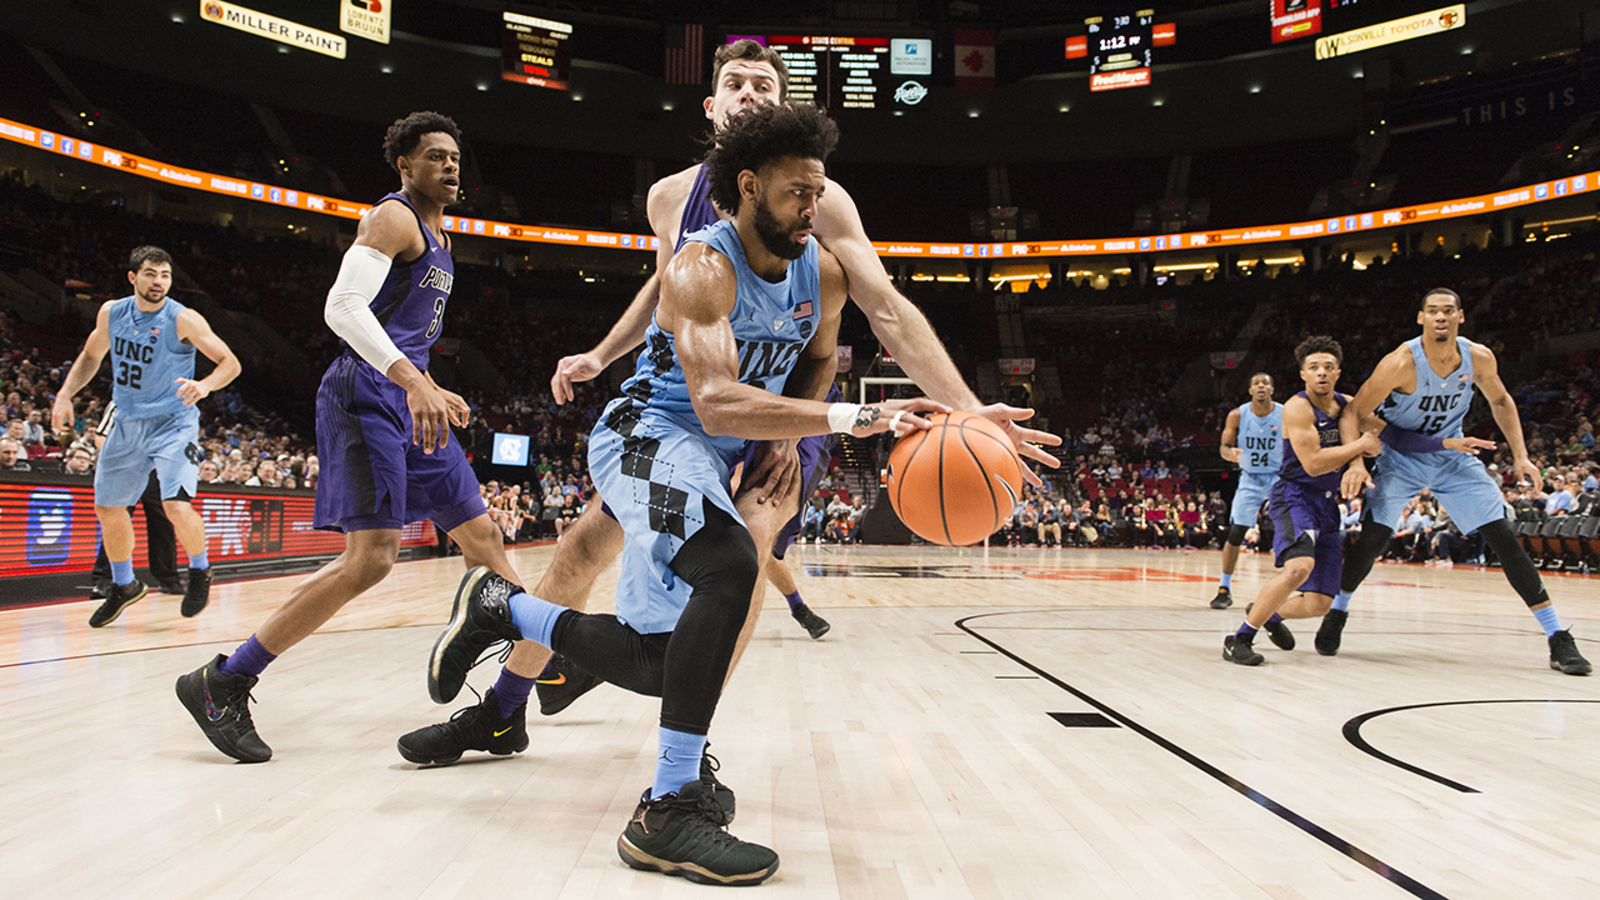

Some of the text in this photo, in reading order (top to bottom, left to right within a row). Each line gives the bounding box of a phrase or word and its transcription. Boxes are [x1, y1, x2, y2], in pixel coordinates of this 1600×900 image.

[346, 9, 385, 27] LORENTZ
[1307, 8, 1320, 19] APP
[226, 10, 290, 37] MILLER
[295, 30, 342, 52] PAINT
[346, 17, 384, 36] BRUUN
[1099, 35, 1126, 50] 1:12
[1318, 27, 1387, 58] WILSONVILLE
[1389, 18, 1435, 35] TOYOTA
[521, 53, 553, 66] STEALS
[523, 64, 550, 77] TOTAL
[1093, 74, 1117, 86] Fred
[1117, 71, 1148, 84] Meyer
[1462, 87, 1575, 126] THIS IS
[425, 297, 445, 339] 3
[114, 336, 154, 364] UNC
[117, 360, 142, 390] 32
[1418, 393, 1462, 412] UNC
[1416, 415, 1448, 436] 15
[1245, 436, 1277, 450] UNC
[1250, 452, 1269, 467] 24
